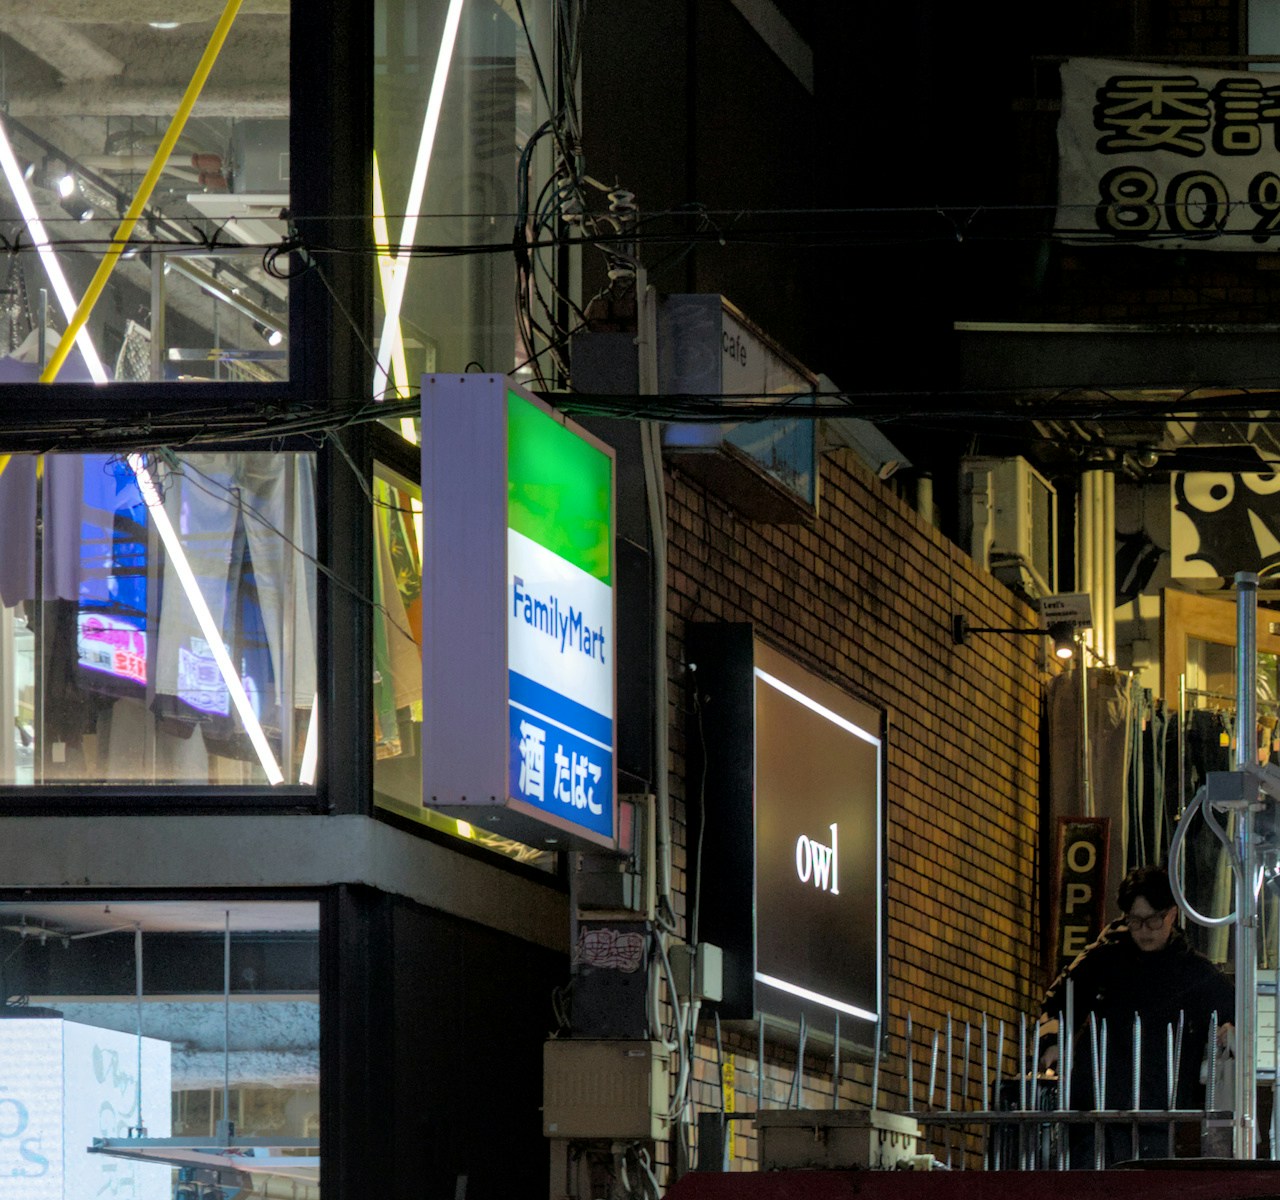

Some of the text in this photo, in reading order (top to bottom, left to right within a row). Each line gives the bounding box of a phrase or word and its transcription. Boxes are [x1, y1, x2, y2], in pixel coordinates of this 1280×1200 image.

[513, 575, 606, 665] FamilyMart
[518, 718, 604, 816] 酒 たばこ
[796, 822, 840, 895] owl
[1063, 840, 1097, 958] OPE
